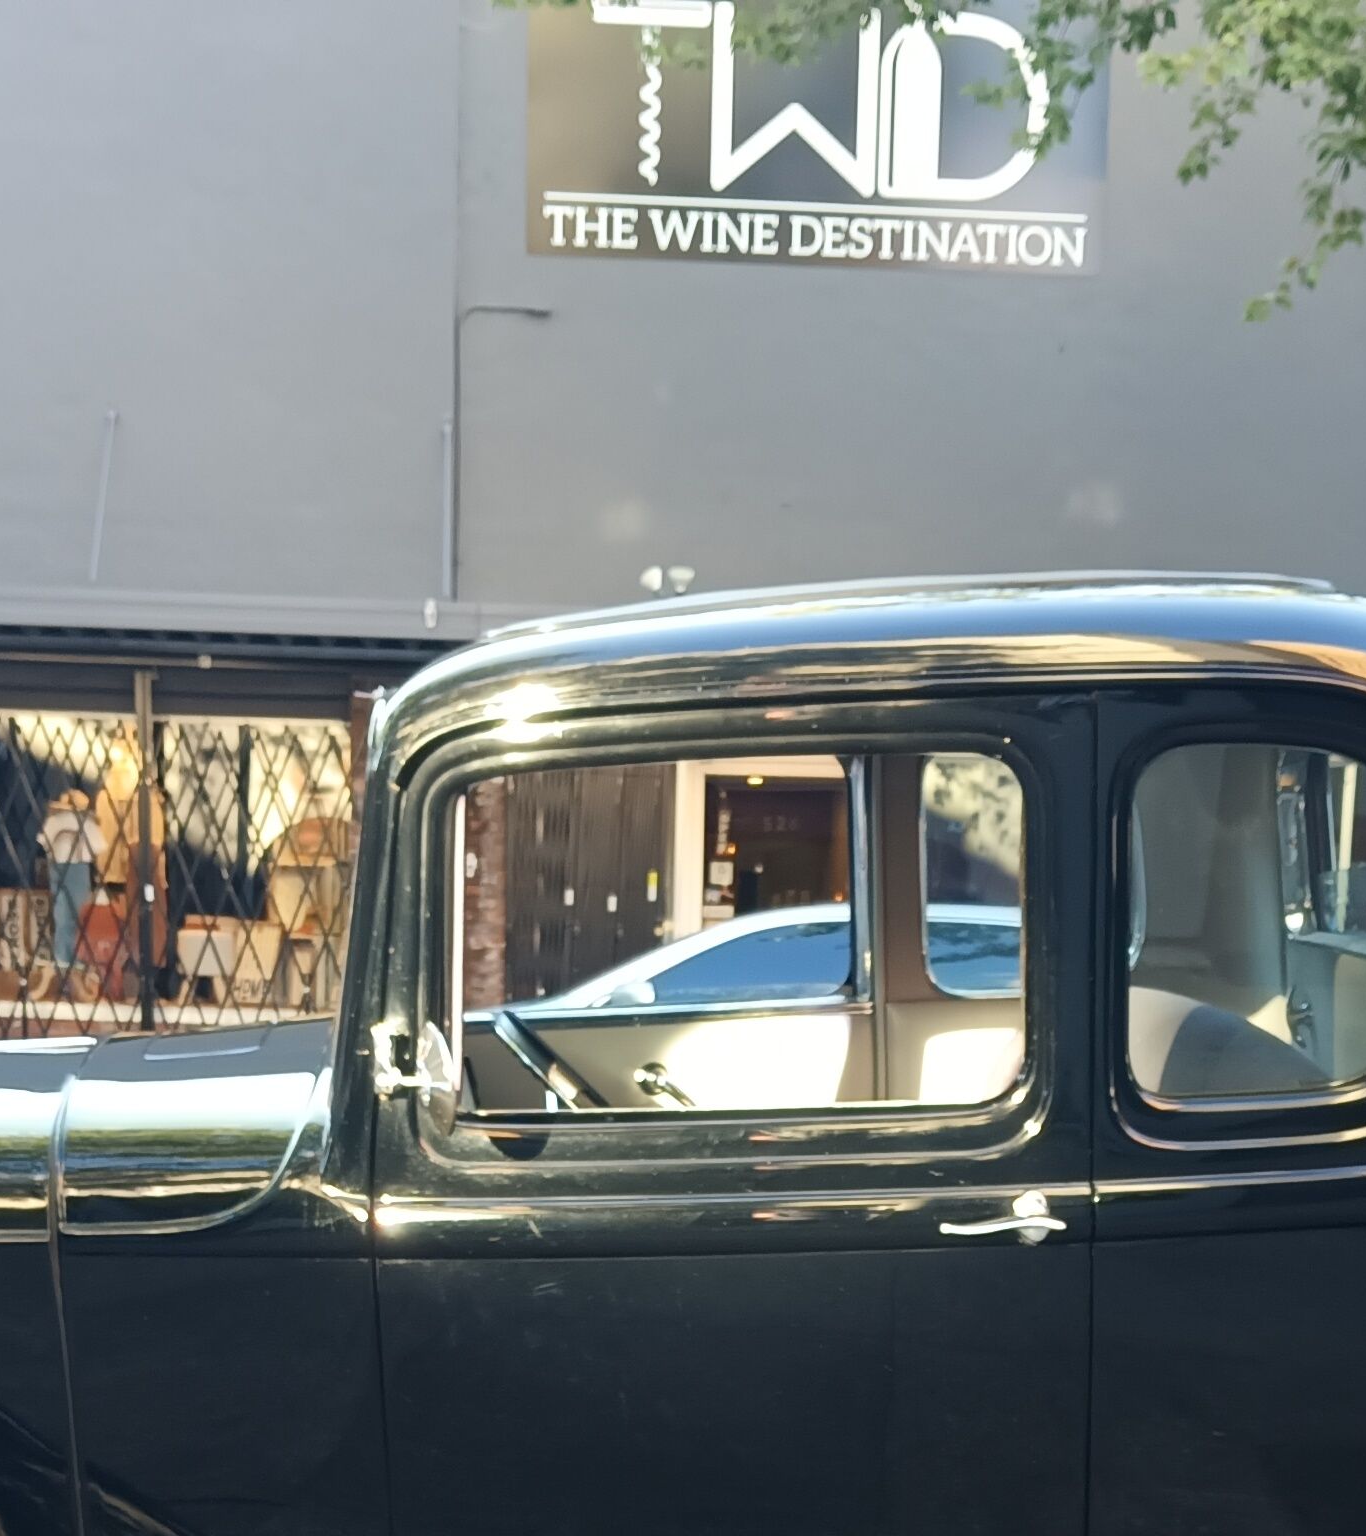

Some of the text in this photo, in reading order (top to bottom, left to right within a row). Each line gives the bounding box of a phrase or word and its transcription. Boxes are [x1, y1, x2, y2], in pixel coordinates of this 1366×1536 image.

[543, 205, 1088, 268] THE WINE DESTINATION
